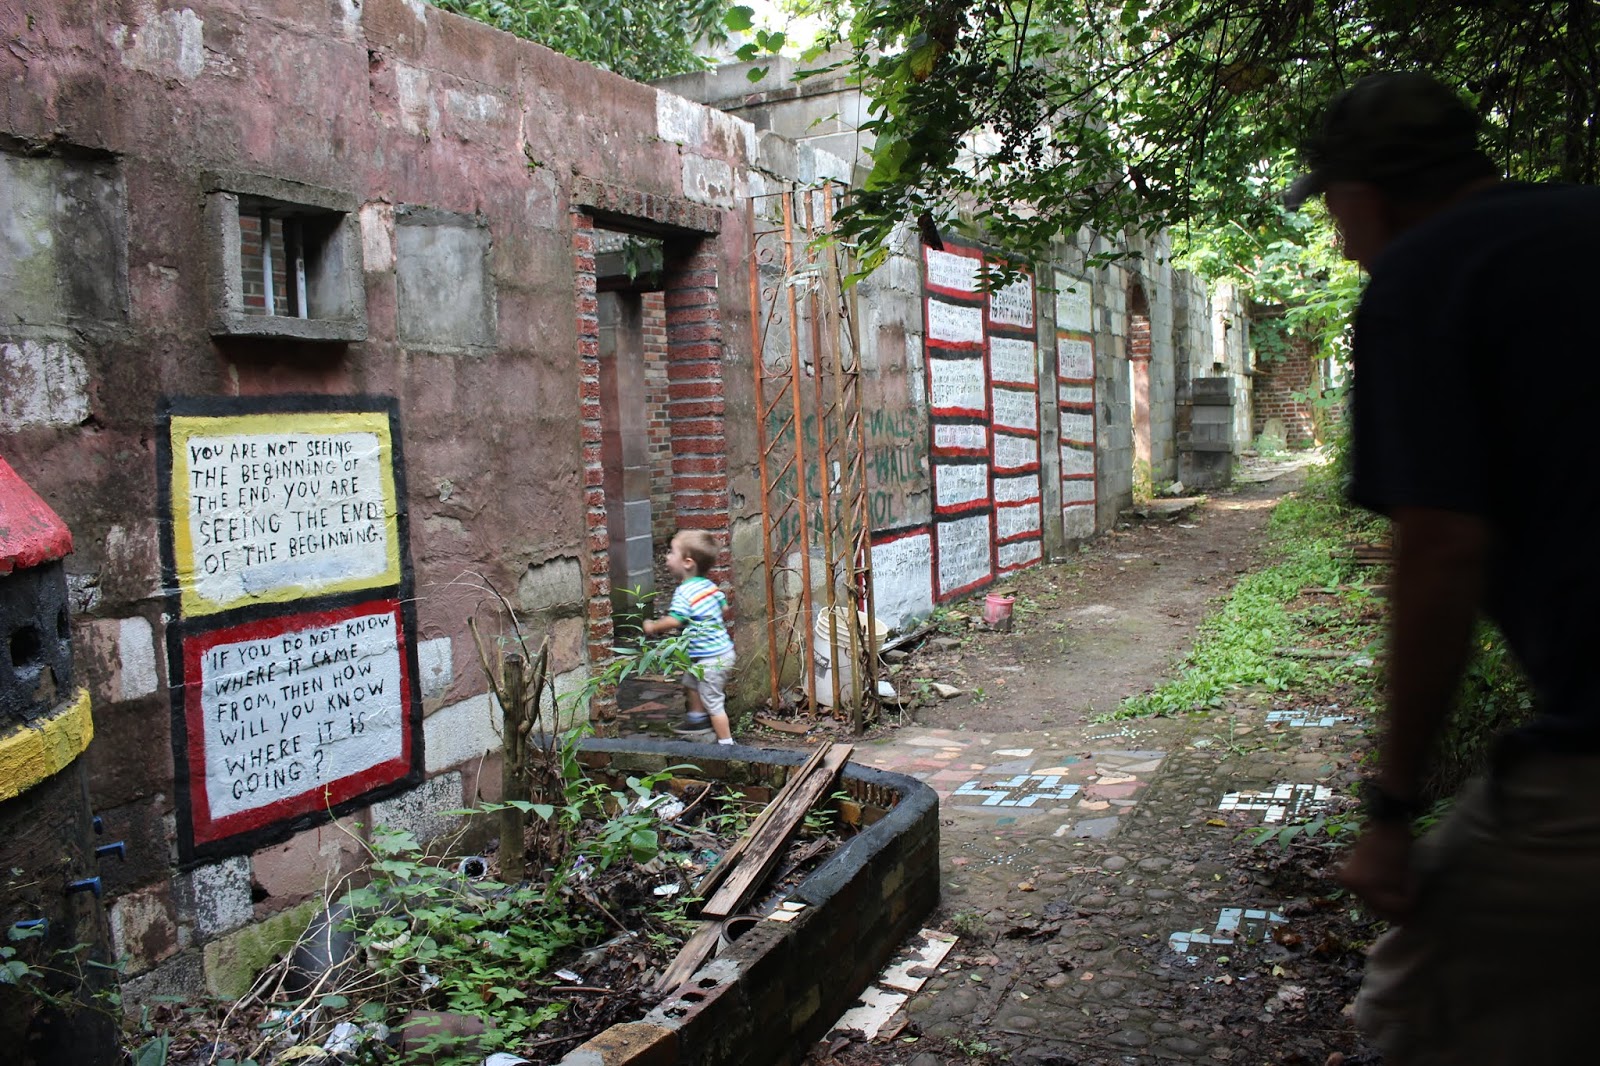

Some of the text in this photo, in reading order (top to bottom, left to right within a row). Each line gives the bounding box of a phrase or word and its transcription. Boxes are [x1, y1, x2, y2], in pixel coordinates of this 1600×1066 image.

[191, 438, 352, 465] YOU ARE NOT SEEING
[191, 466, 228, 488] THE
[344, 459, 359, 472] OF
[193, 477, 359, 514] THE END. YOU ARE
[200, 502, 378, 546] SEEING THE END
[205, 551, 230, 574] OF
[243, 542, 277, 566] THE
[213, 615, 391, 670] IF YOU DO NOT KNOW
[215, 644, 358, 696] WHERE IT CAME
[217, 663, 371, 722] FROM, THEN HOW
[220, 678, 384, 746] WILL YOU KNOW
[225, 735, 302, 776] WHERE
